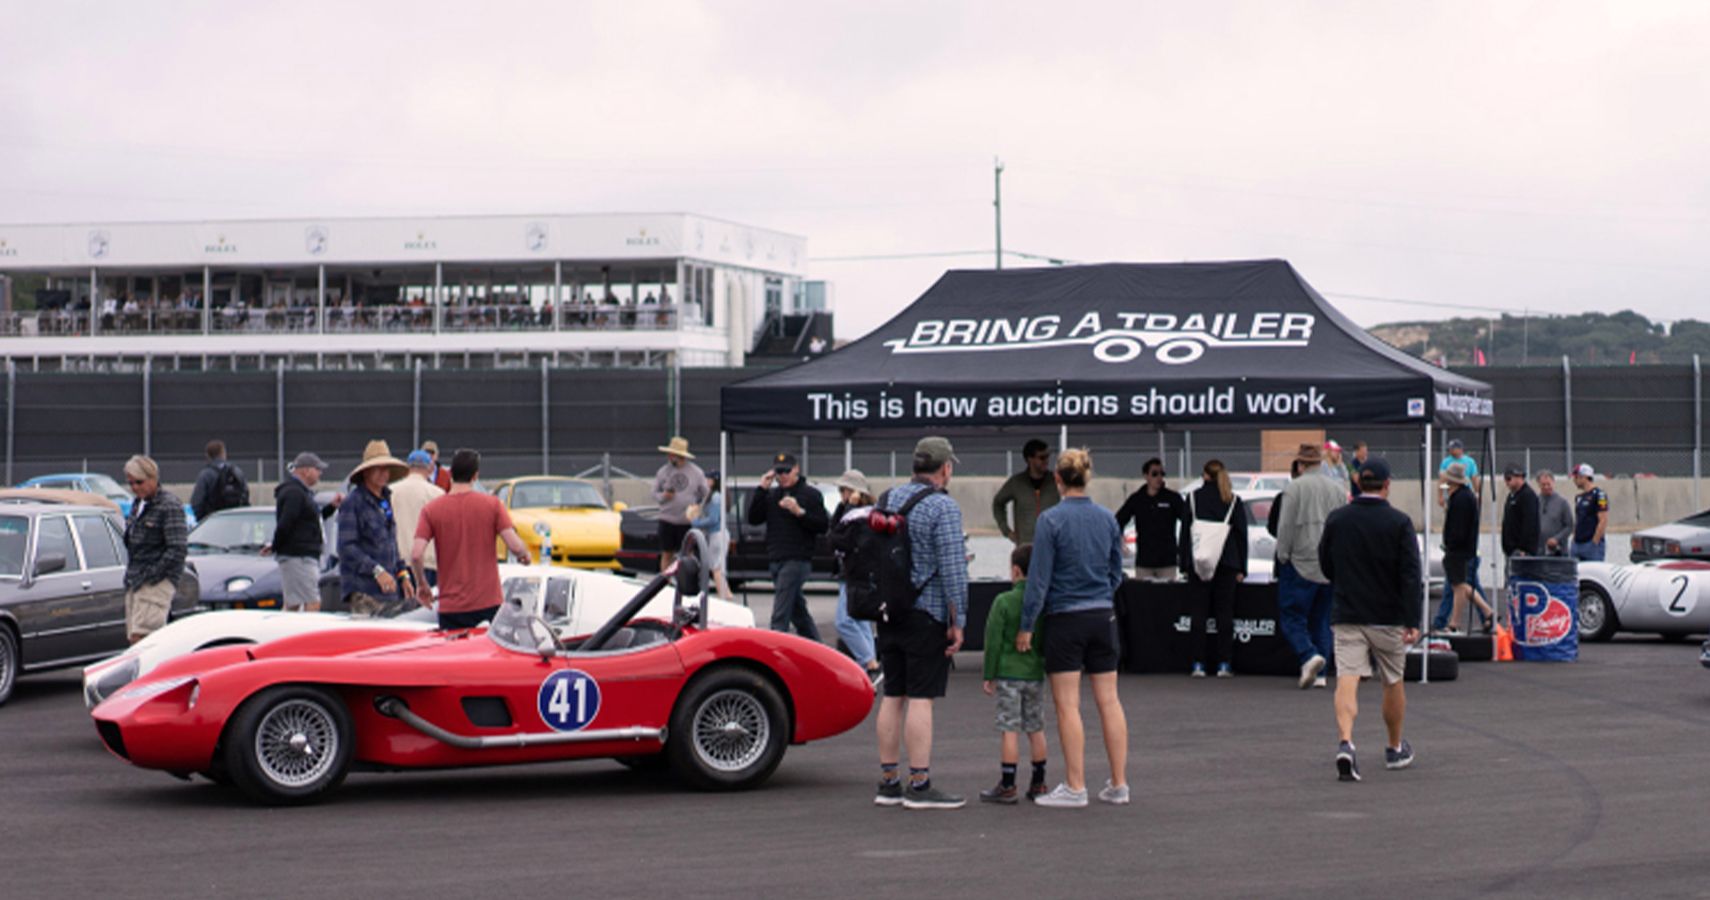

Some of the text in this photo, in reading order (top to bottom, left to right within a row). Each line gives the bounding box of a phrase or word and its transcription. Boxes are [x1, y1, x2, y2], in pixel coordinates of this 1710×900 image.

[908, 315, 1061, 347] BRING
[1068, 312, 1102, 338] A
[807, 385, 1335, 420] This is how auctions should work.
[1669, 574, 1689, 613] 2
[548, 677, 587, 724] 41
